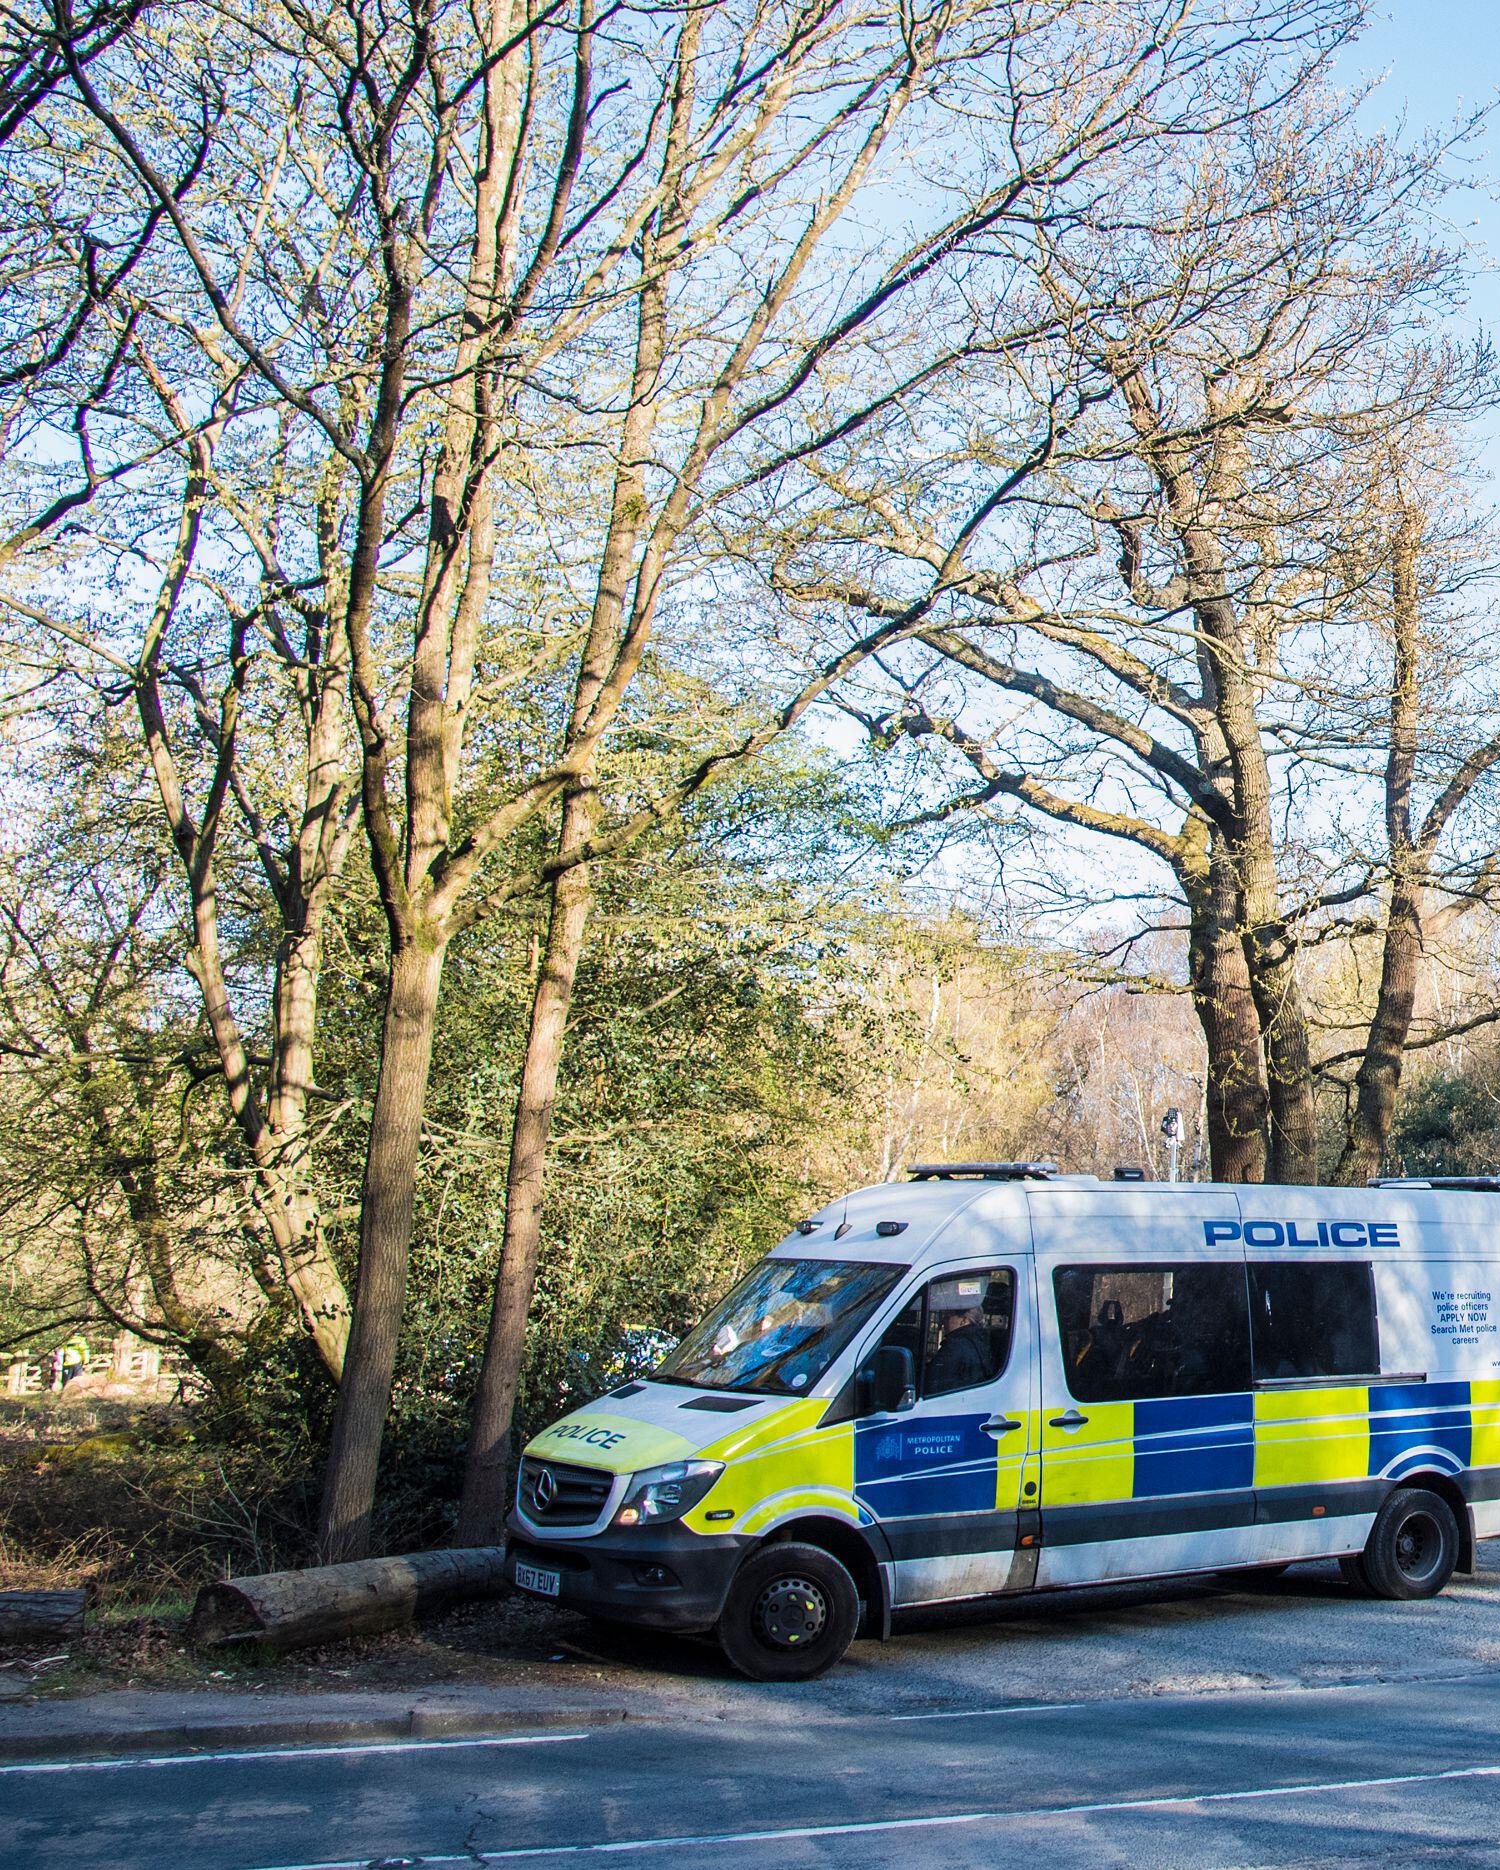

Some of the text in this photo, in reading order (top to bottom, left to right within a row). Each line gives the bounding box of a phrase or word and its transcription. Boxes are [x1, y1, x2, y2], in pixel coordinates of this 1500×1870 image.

[1203, 1220, 1401, 1247] POLICE
[1432, 1291, 1491, 1301] We're recruiting
[1437, 1302, 1489, 1313] police officers
[1440, 1313, 1487, 1322] APPLY NOW
[1431, 1323, 1497, 1334] Search Met police
[545, 1425, 627, 1449] POLICE
[906, 1435, 960, 1444] METROPOLITAN
[914, 1445, 953, 1454] POLICE
